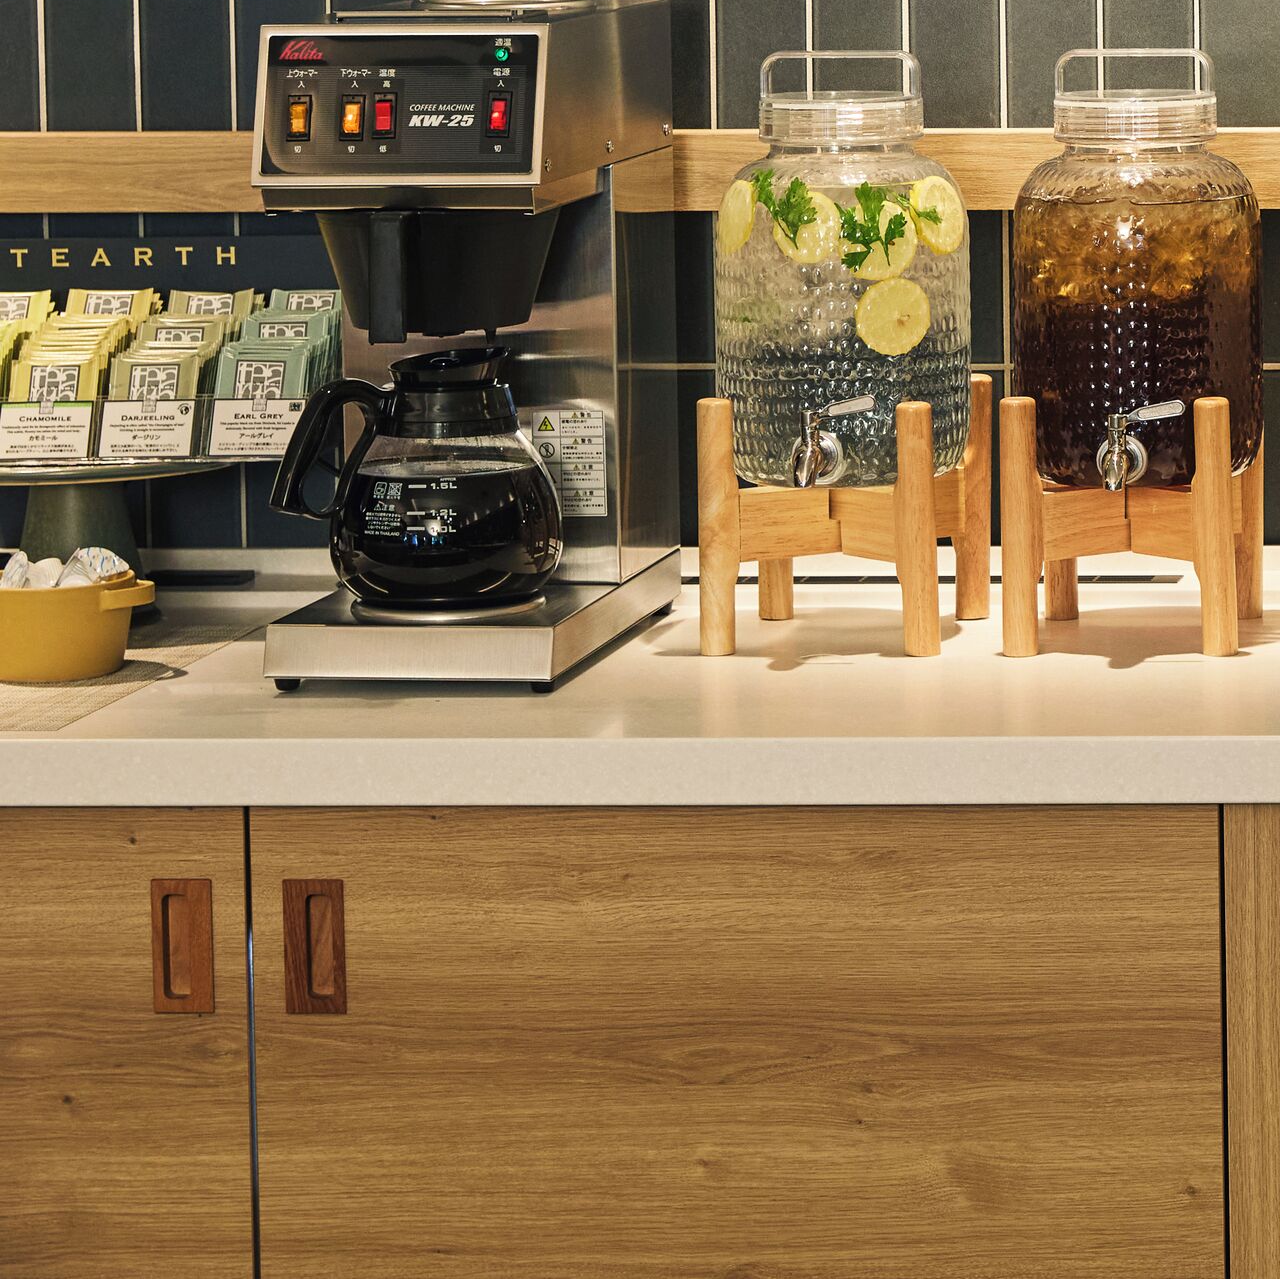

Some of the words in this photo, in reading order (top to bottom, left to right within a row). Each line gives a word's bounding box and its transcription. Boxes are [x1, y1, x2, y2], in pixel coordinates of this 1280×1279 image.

[280, 39, 324, 60] Kalita
[492, 67, 511, 77] 電源
[297, 80, 306, 88] 入
[351, 80, 359, 88] 入
[496, 79, 505, 88] 入
[409, 103, 437, 112] COFFEE
[437, 103, 476, 112] MACHINE
[408, 114, 475, 127] KW-25
[9, 246, 237, 268] TEARTH
[19, 415, 72, 423] CHAMOMILE
[259, 412, 284, 420] GREY
[430, 482, 457, 490] 1.5L
